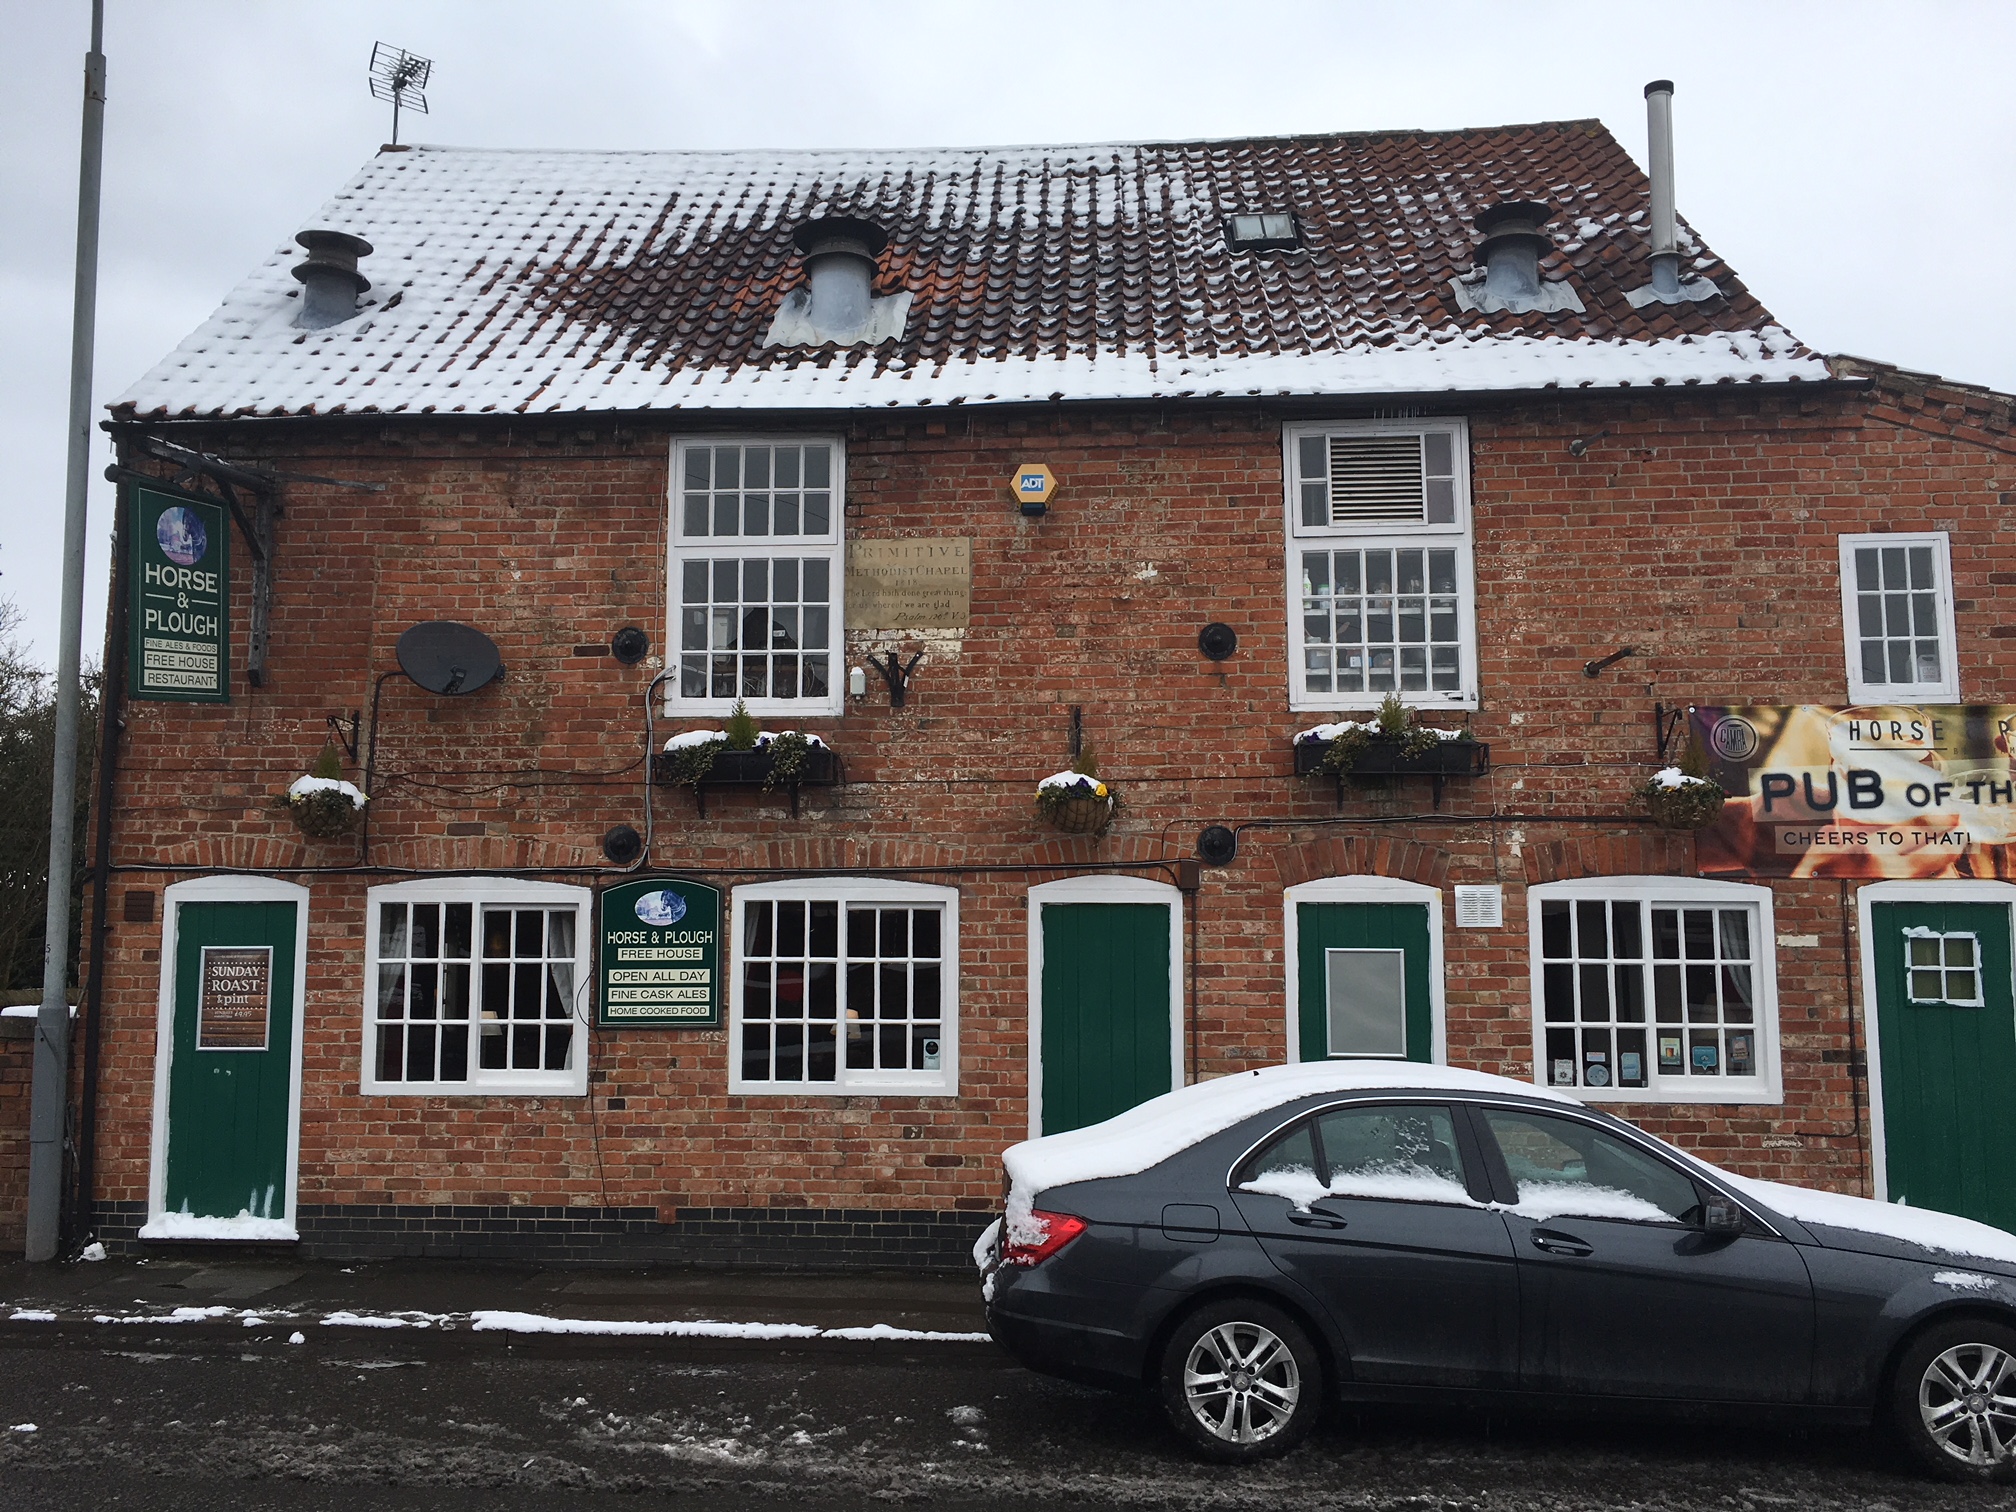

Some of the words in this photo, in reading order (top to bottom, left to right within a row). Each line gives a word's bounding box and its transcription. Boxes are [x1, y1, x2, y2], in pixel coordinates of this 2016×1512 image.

[1021, 478, 1044, 489] ADT
[849, 544, 965, 559] PRIMITIVE
[916, 564, 968, 576] CHAPEL
[145, 562, 218, 594] HORSE
[177, 592, 189, 609] &
[861, 589, 880, 597] Lord
[882, 588, 900, 597] hath
[901, 588, 920, 597] done
[922, 590, 941, 599] great
[872, 600, 903, 609] whereof
[145, 608, 218, 637] PLOUGH
[894, 612, 926, 621] Psalm
[145, 639, 163, 648] FINE
[165, 640, 184, 650] ALES
[192, 643, 217, 653] FOODS
[146, 654, 175, 667] FREE
[178, 656, 215, 669] HOUSE
[147, 673, 214, 687] RESTAURANT
[1849, 719, 1945, 741] HORSE
[1761, 769, 1885, 813] PUB
[1905, 783, 1953, 807] OF
[1784, 831, 1868, 846] CHEERS
[1876, 831, 1904, 846] TO
[1911, 831, 1971, 846] THAT!
[607, 931, 647, 944] HORSE
[651, 931, 660, 944] &
[664, 930, 713, 944] PLOUGH
[621, 949, 653, 959] FREE
[657, 949, 700, 958] HOUSE
[211, 966, 260, 977] SUNDAY
[612, 971, 648, 981] OPEN
[652, 971, 675, 981] ALL
[679, 971, 706, 981] DAY
[211, 979, 260, 991] ROAST
[223, 992, 249, 1006] pint
[611, 990, 637, 999] FINE
[640, 990, 673, 999] CASK
[677, 990, 707, 999] ALES
[610, 1007, 638, 1015] HOME
[639, 1007, 679, 1015] COOKED
[680, 1007, 707, 1015] FOOD
